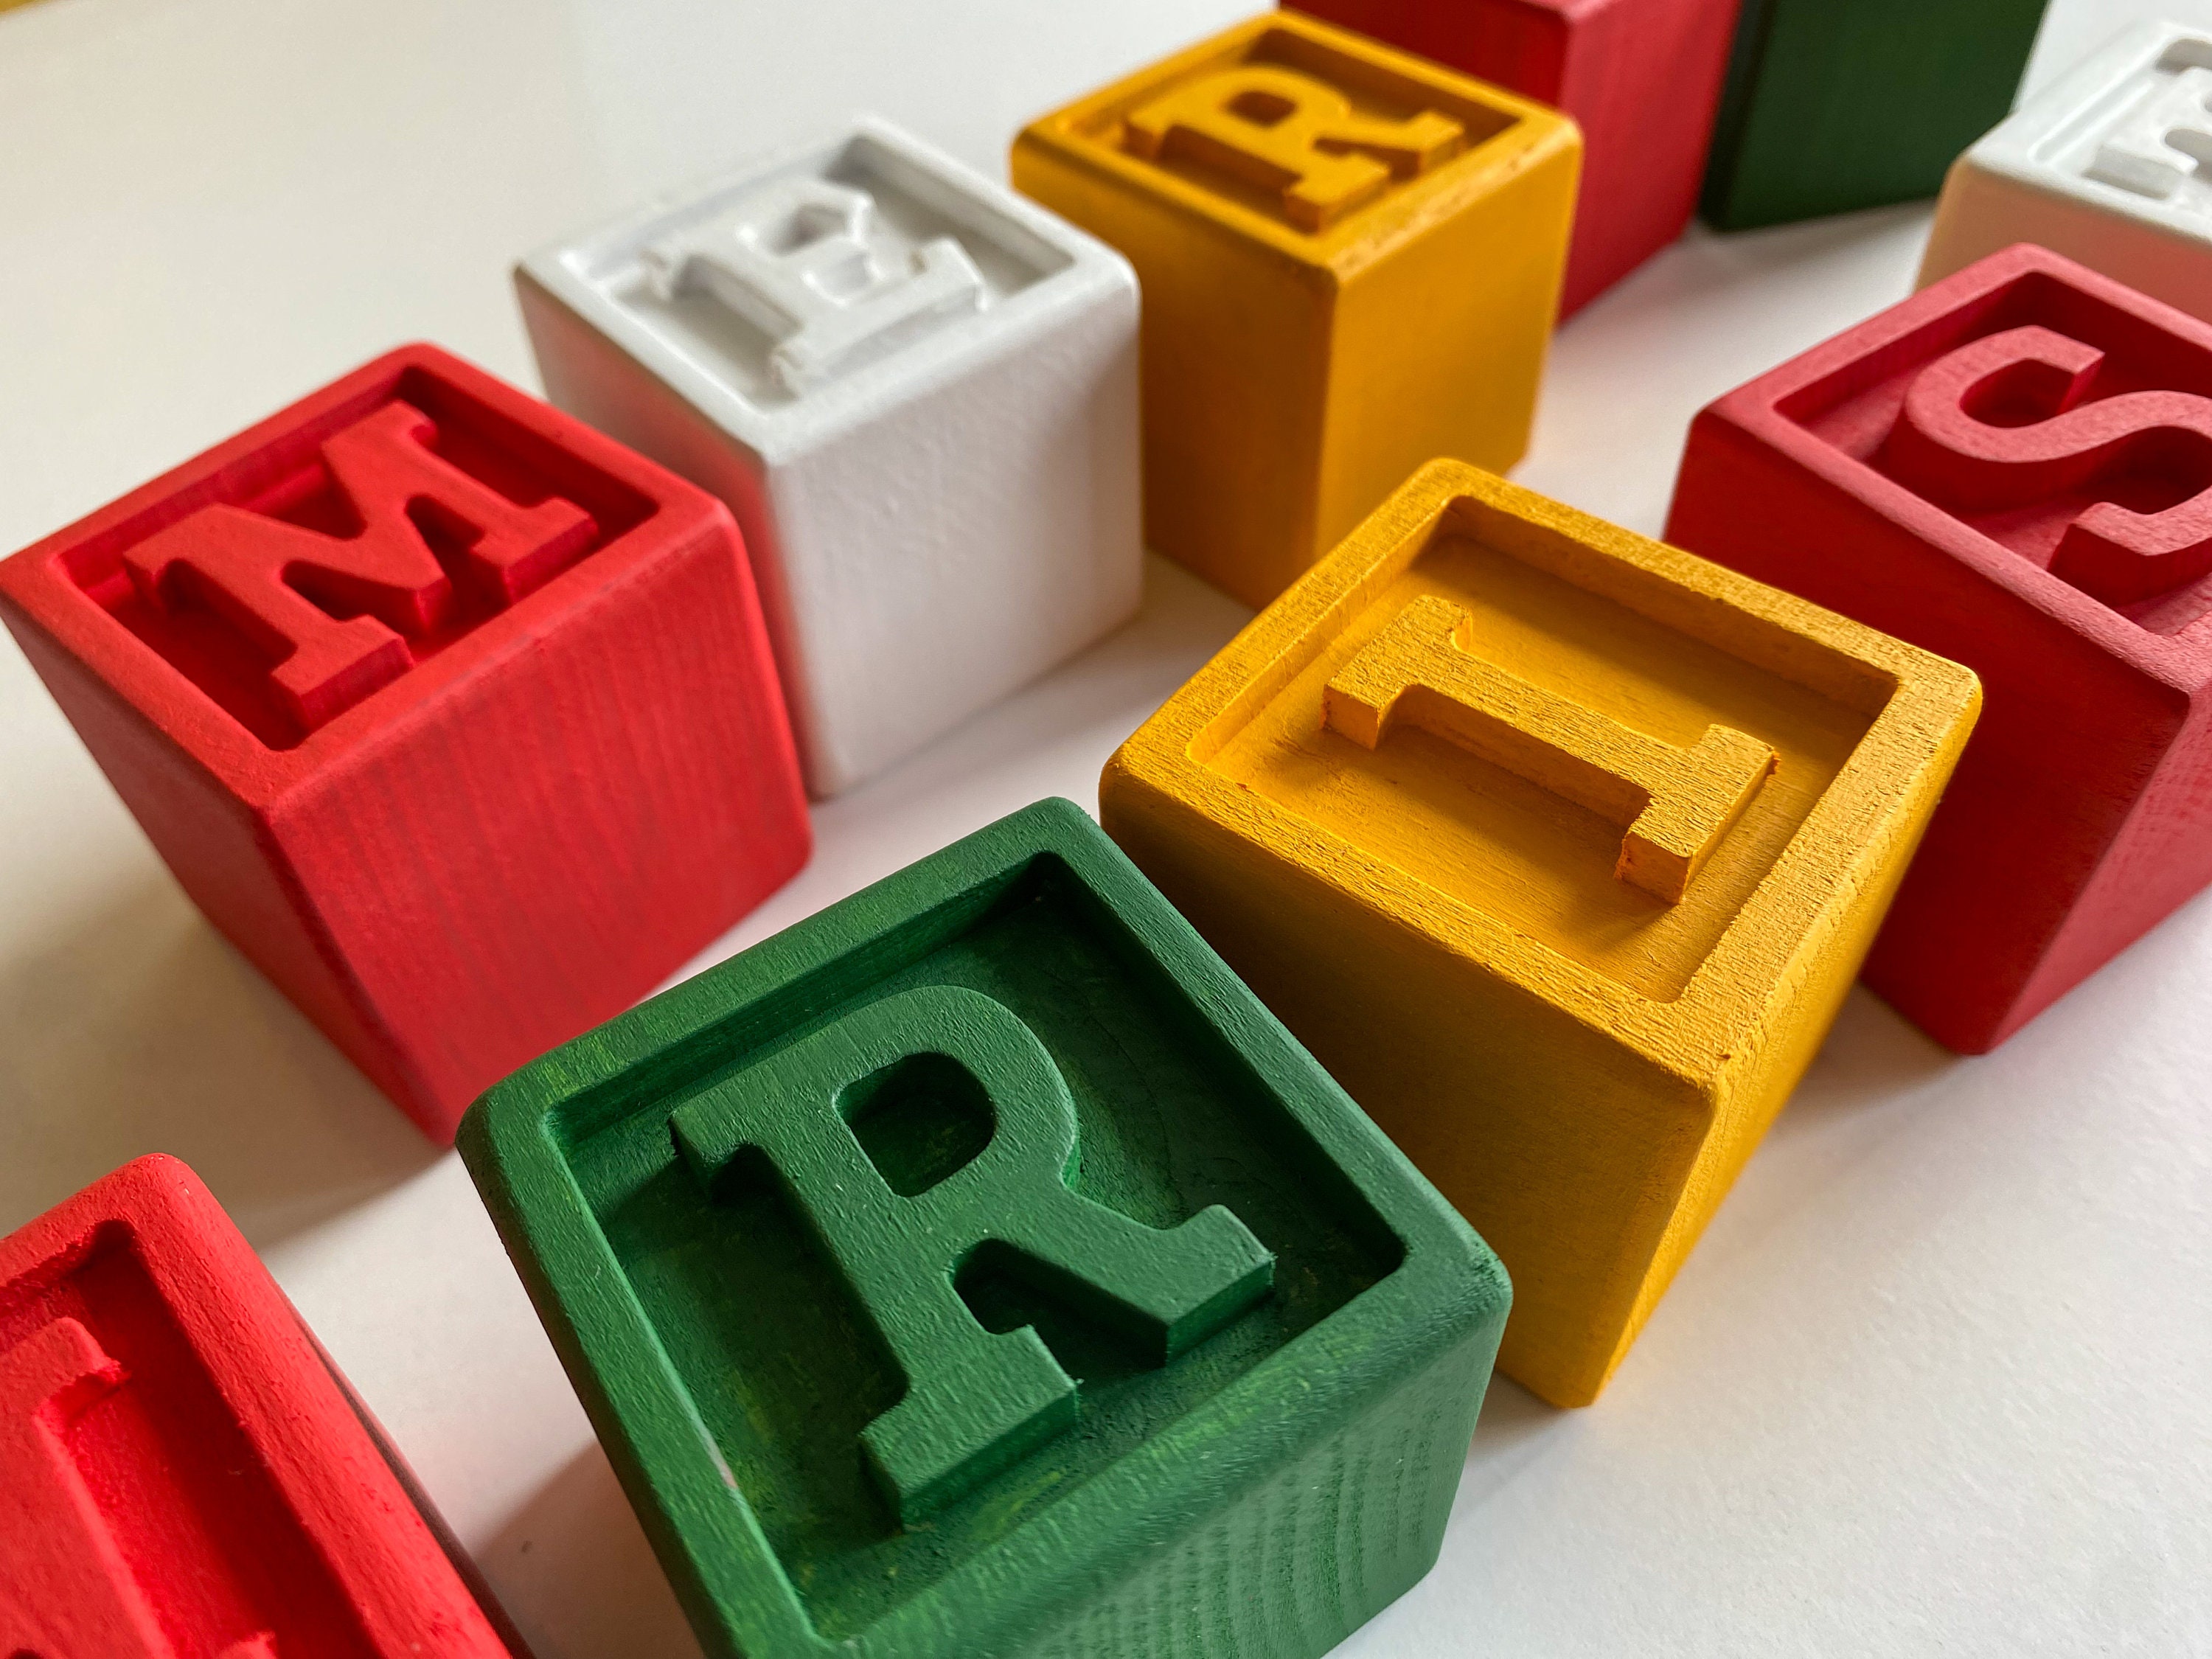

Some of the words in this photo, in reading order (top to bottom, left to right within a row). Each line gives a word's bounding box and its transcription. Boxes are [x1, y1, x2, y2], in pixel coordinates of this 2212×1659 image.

[1124, 63, 1466, 225] R
[640, 178, 988, 383] E
[124, 400, 594, 712] M
[1905, 324, 2212, 579] S
[1326, 594, 1777, 881] I
[669, 984, 1273, 1523] R
